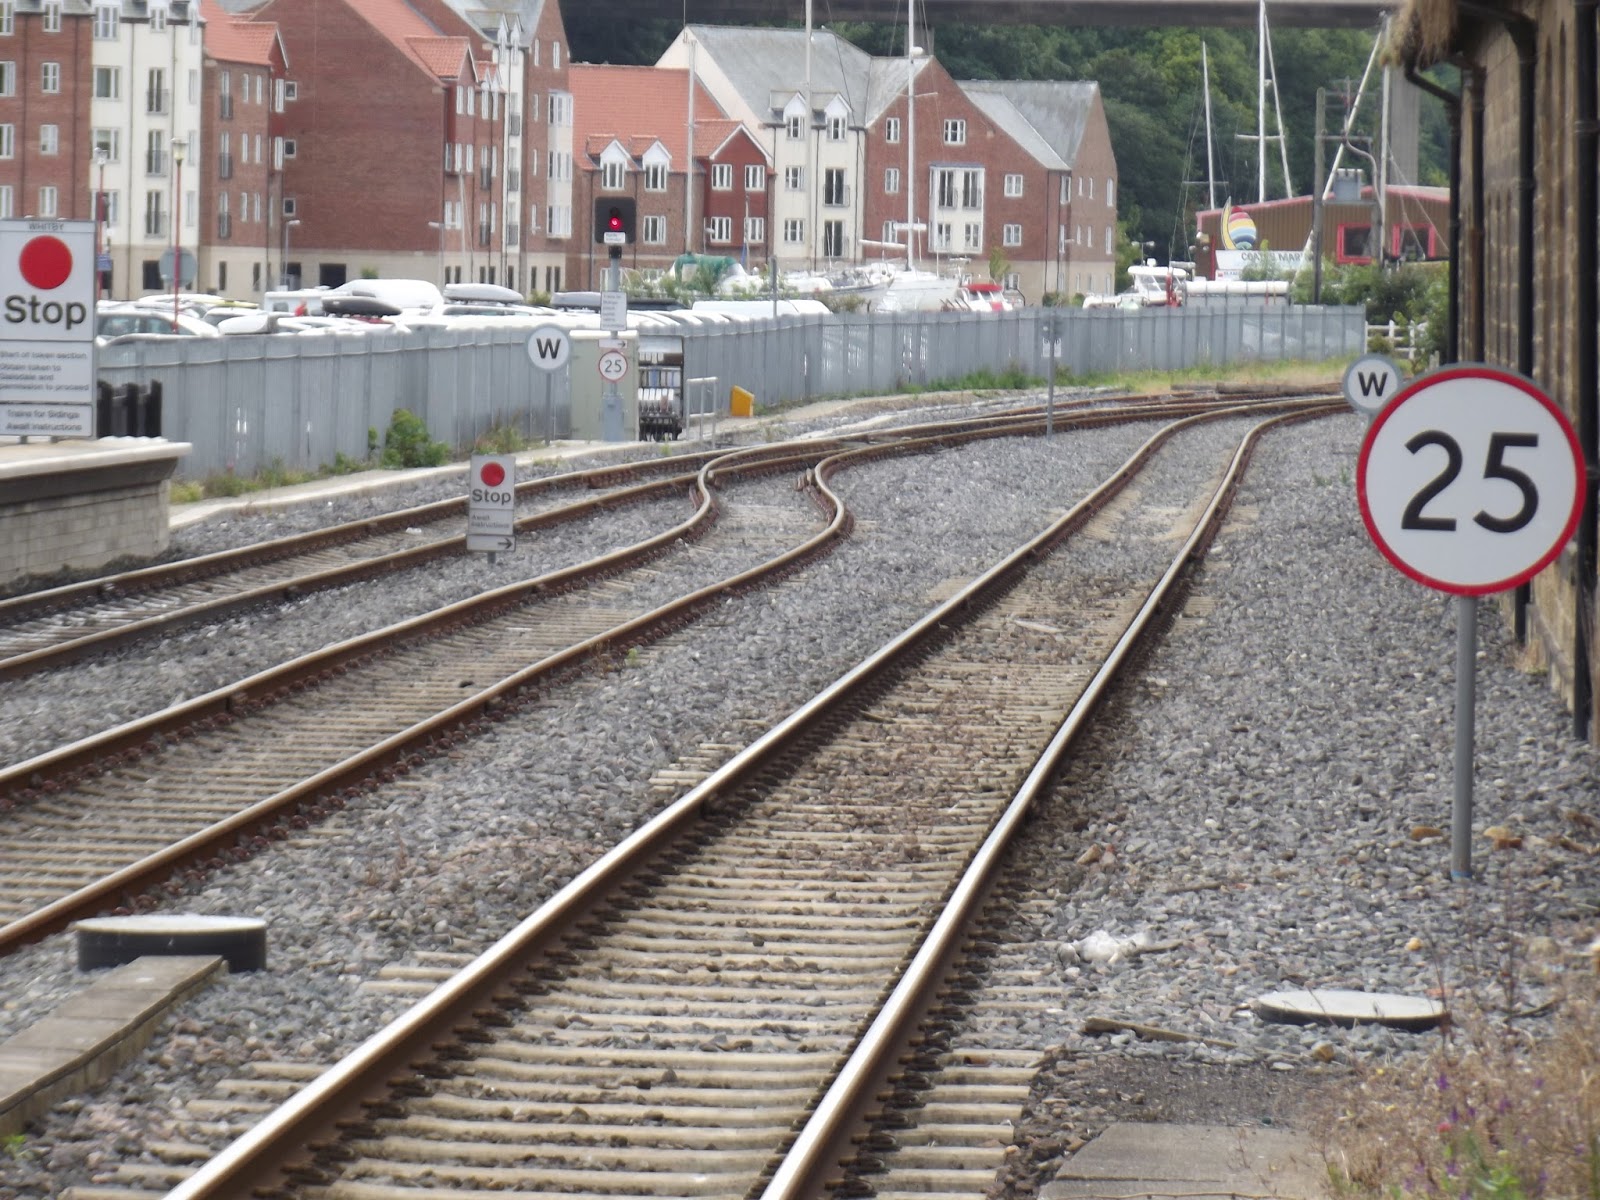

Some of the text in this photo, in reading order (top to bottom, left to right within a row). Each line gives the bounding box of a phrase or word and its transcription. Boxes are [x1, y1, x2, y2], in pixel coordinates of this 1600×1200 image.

[29, 222, 65, 232] WHITBY
[4, 295, 87, 330] Stop
[536, 338, 561, 360] W
[604, 359, 622, 374] 25
[1358, 371, 1388, 397] W
[1401, 429, 1539, 533] 25
[472, 489, 511, 505] Stop
